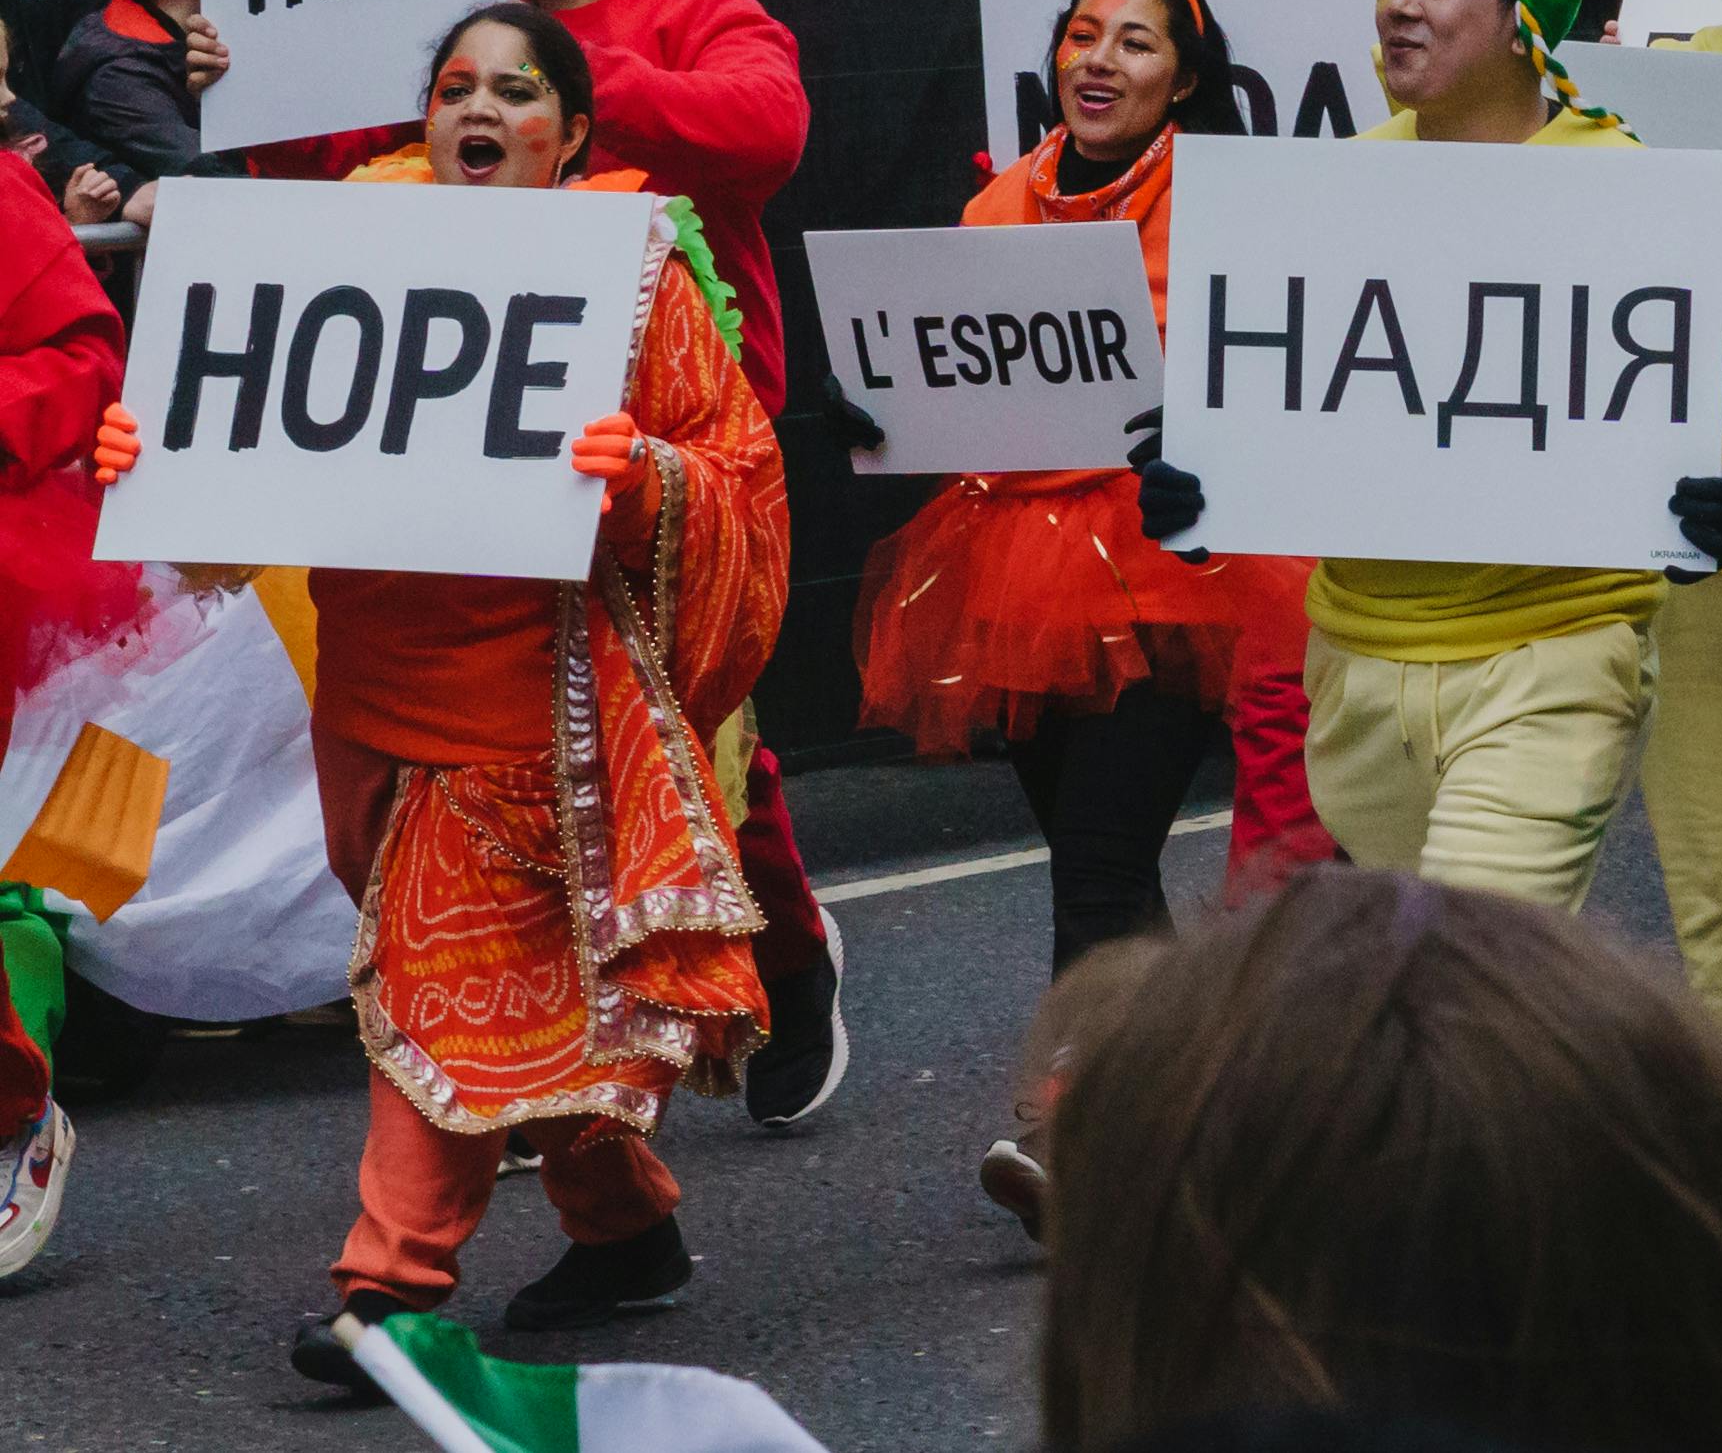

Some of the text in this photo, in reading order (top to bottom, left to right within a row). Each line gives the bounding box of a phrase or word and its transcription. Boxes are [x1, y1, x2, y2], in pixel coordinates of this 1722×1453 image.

[162, 282, 587, 459] HOPE
[851, 308, 1138, 390] L' ESPOIR
[1206, 274, 1692, 452] НАДІЯ
[1650, 550, 1701, 560] UKRAINIAN
